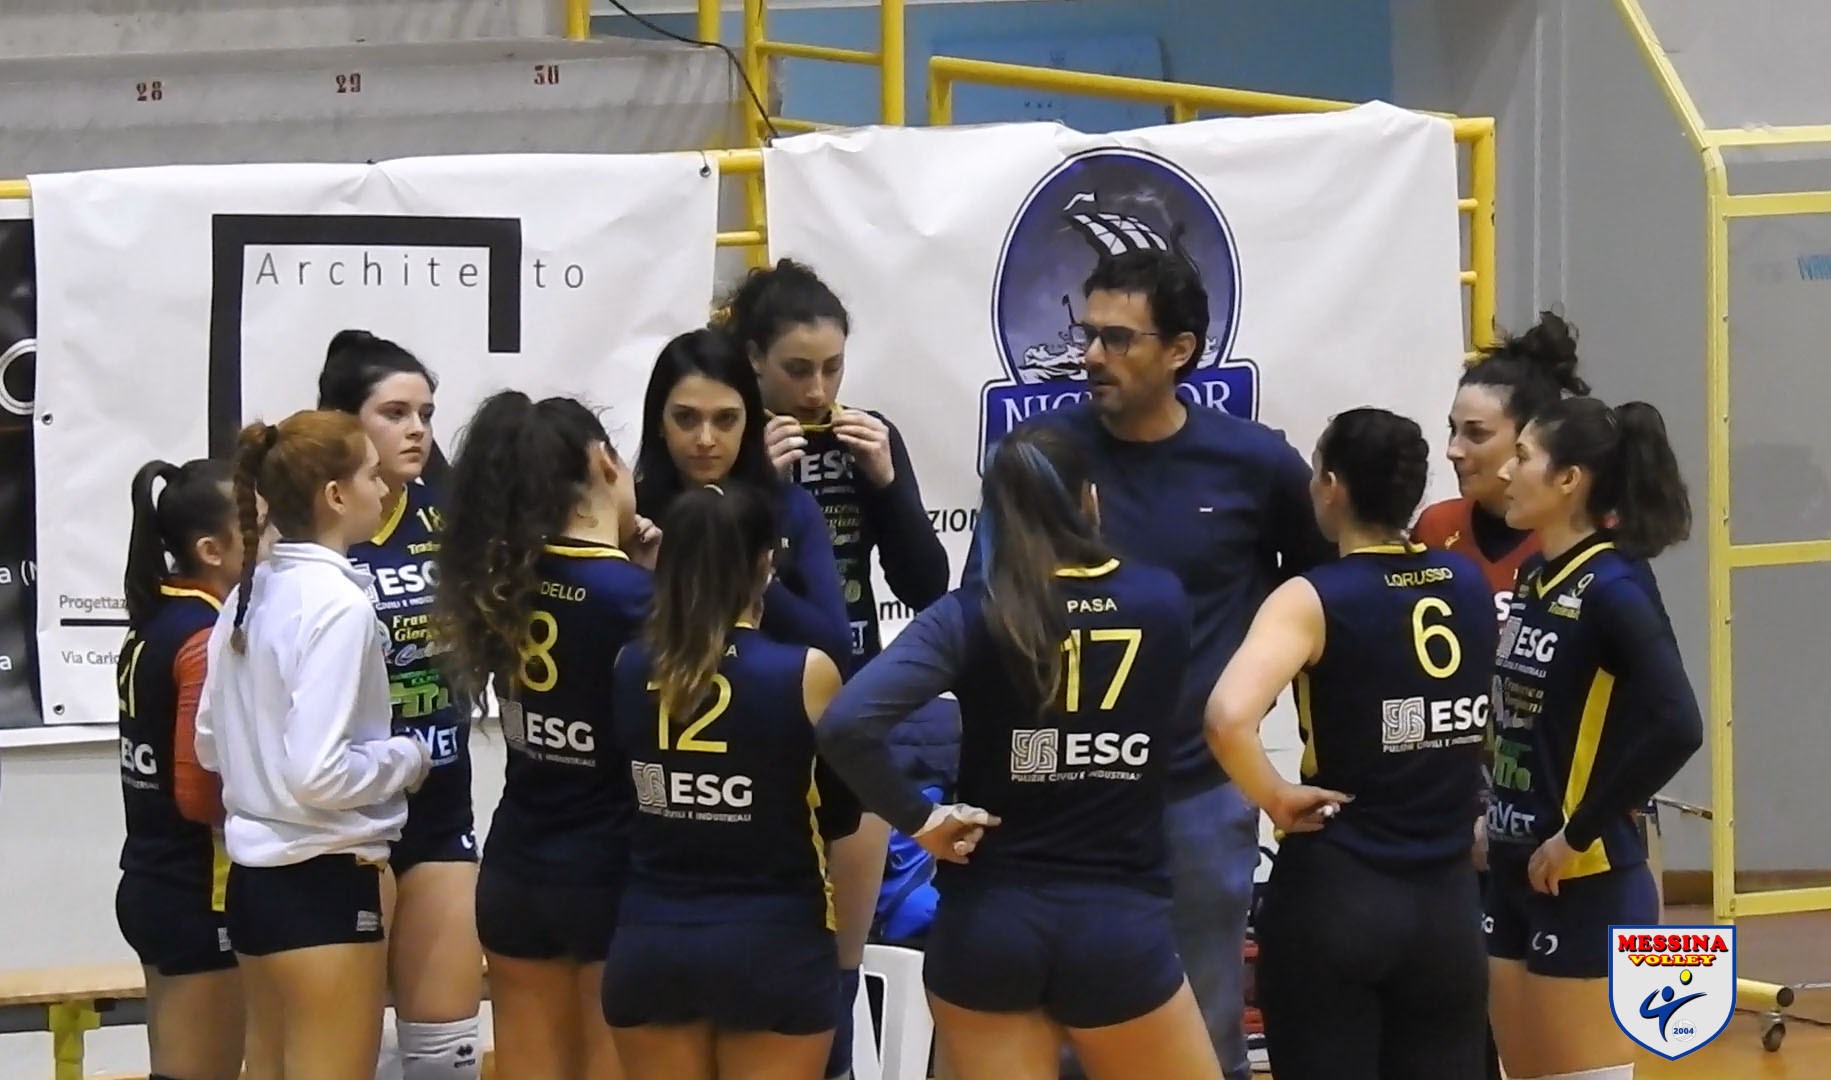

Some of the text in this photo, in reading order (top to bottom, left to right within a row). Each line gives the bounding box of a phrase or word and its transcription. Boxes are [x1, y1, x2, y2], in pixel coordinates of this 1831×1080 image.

[135, 81, 163, 102] 28
[335, 73, 361, 94] 29
[255, 252, 479, 287] Archite
[1384, 567, 1454, 588] LORUSSO
[1067, 598, 1118, 613] PASA
[518, 610, 559, 692] 8
[1412, 596, 1462, 679] 6
[1513, 625, 1558, 663] ESG
[61, 651, 83, 665] Via
[1060, 628, 1143, 713] 17
[646, 673, 732, 753] 12
[1430, 694, 1490, 733] ESG
[526, 711, 595, 752] ESG
[1066, 732, 1150, 766] ESG
[670, 772, 753, 808] ESG
